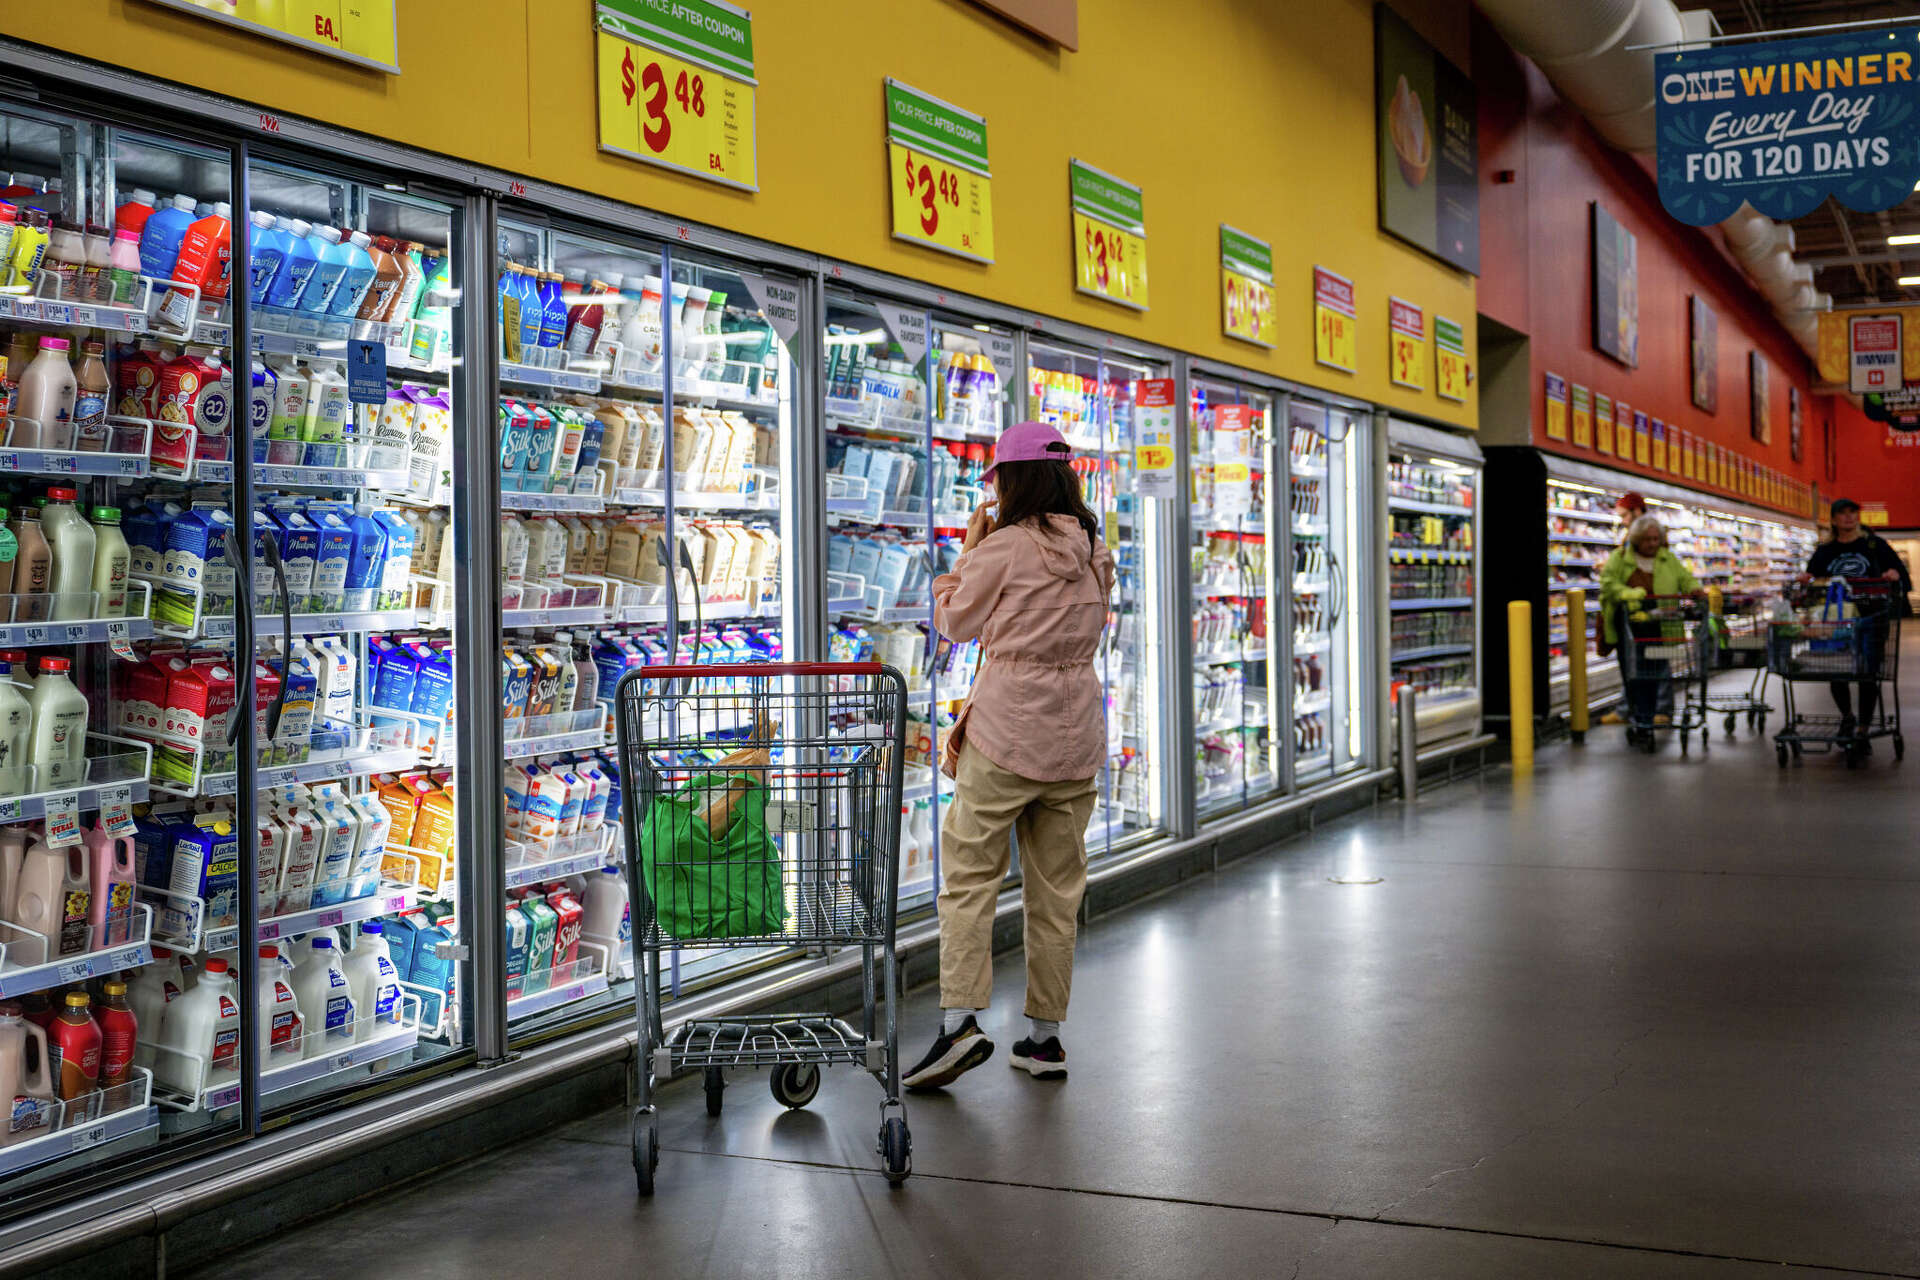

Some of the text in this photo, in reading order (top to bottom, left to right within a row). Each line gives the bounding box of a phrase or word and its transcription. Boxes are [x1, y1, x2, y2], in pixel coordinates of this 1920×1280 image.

[315, 14, 339, 42] EA.
[670, 2, 704, 29] AFTER
[704, 15, 745, 45] COUPON
[1662, 51, 1913, 105] ONE WINNER
[894, 99, 982, 145] YOUR PRICE AFTER COUPON
[1705, 92, 1875, 145] Every Day
[709, 153, 725, 173] EA.
[1686, 150, 1743, 183] FOR
[1751, 144, 1803, 177] 120
[1813, 136, 1890, 172] DAYS
[766, 284, 797, 305] NON-DAIRY
[767, 303, 797, 323] FAVORITES
[205, 400, 224, 417] a2
[503, 431, 530, 456] Silk
[529, 432, 554, 458] Silk
[504, 678, 531, 706] Silk
[531, 677, 561, 704] Silk
[50, 821, 75, 835] TEXAS
[105, 813, 128, 827] TEXAS
[179, 839, 201, 854] Lactaid
[530, 928, 555, 960] Silk
[554, 920, 581, 952] Silk
